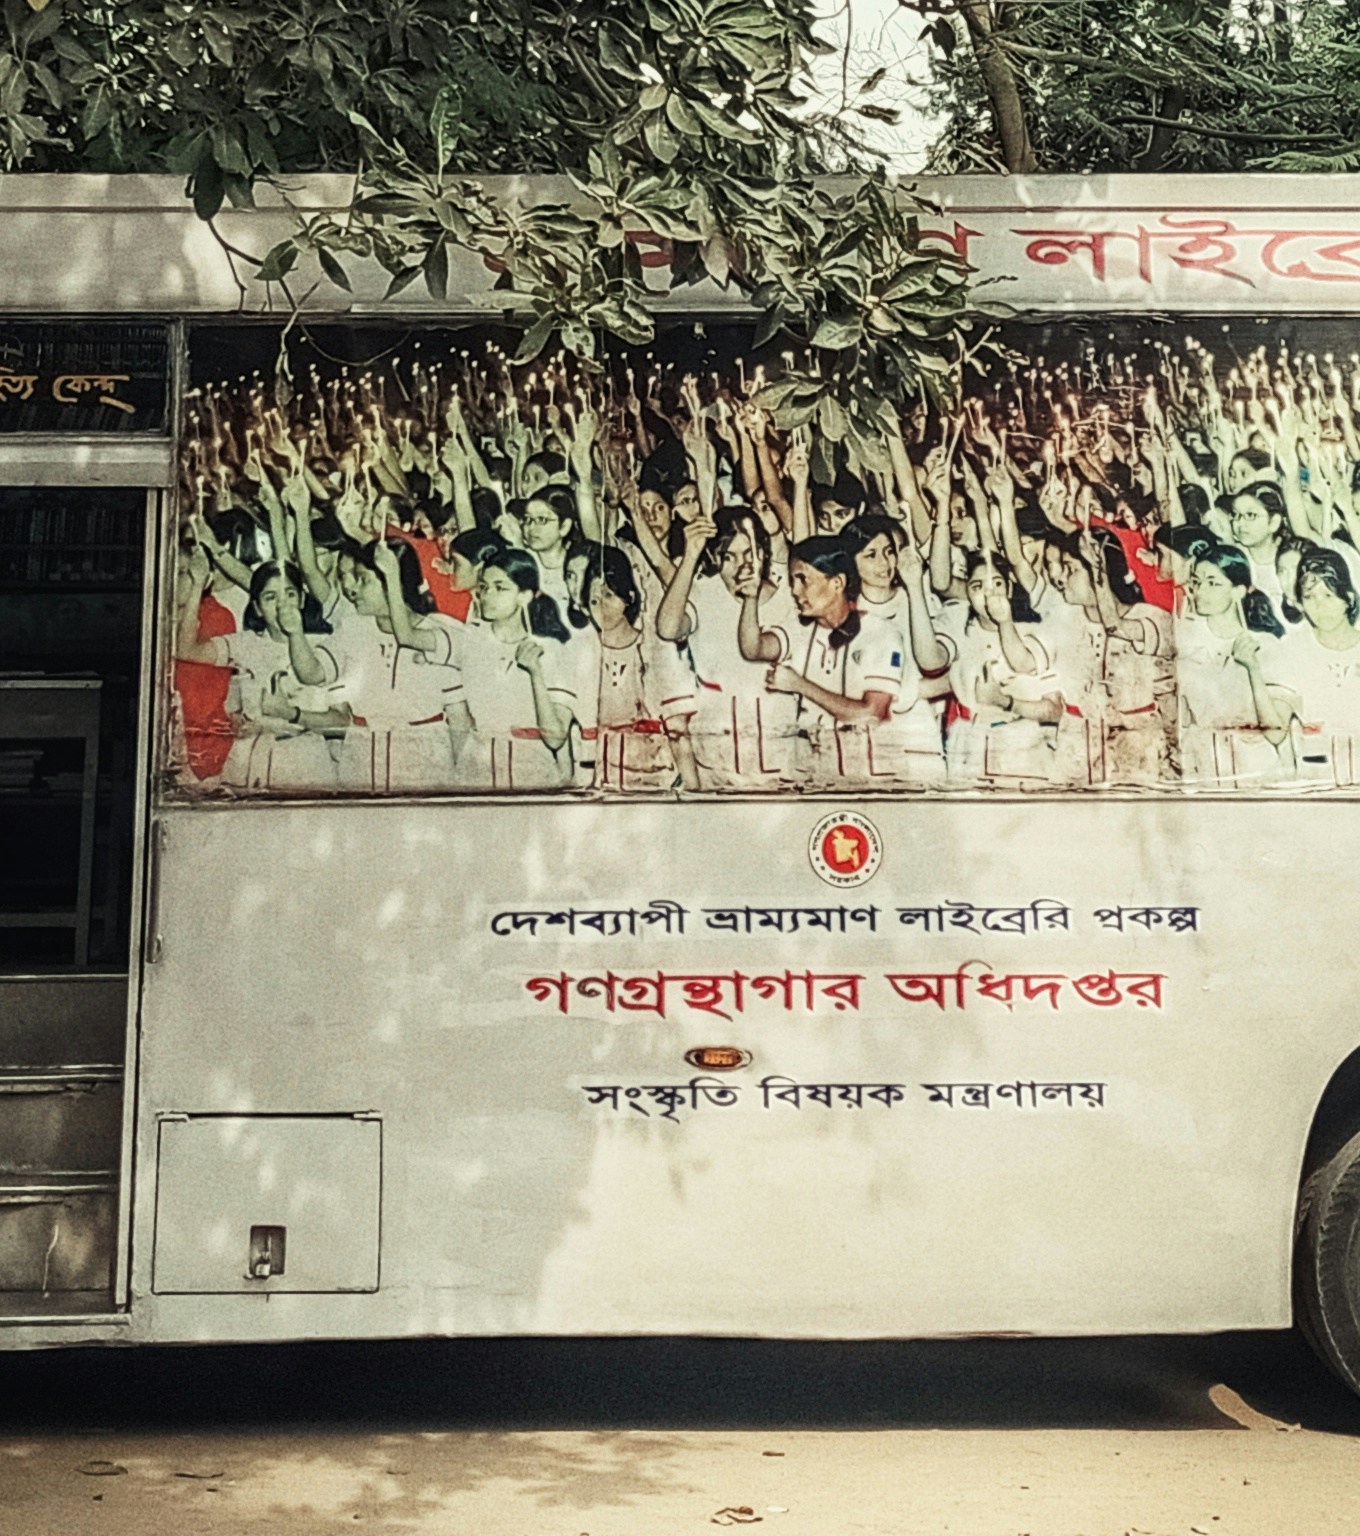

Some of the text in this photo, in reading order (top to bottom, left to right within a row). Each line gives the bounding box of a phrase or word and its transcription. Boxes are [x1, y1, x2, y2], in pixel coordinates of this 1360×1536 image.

[52, 374, 136, 414] কেন্দ্র
[490, 899, 1201, 937] দেশব্যাপী ভ্রাম্যমাণ লাইব্রেরি প্রকল্প
[525, 959, 1168, 1021] গণগ্রন্থাগার অধিদপ্তর
[581, 1075, 1108, 1124] সংস্কৃতি বিষয়ক মন্ত্রণালয়
